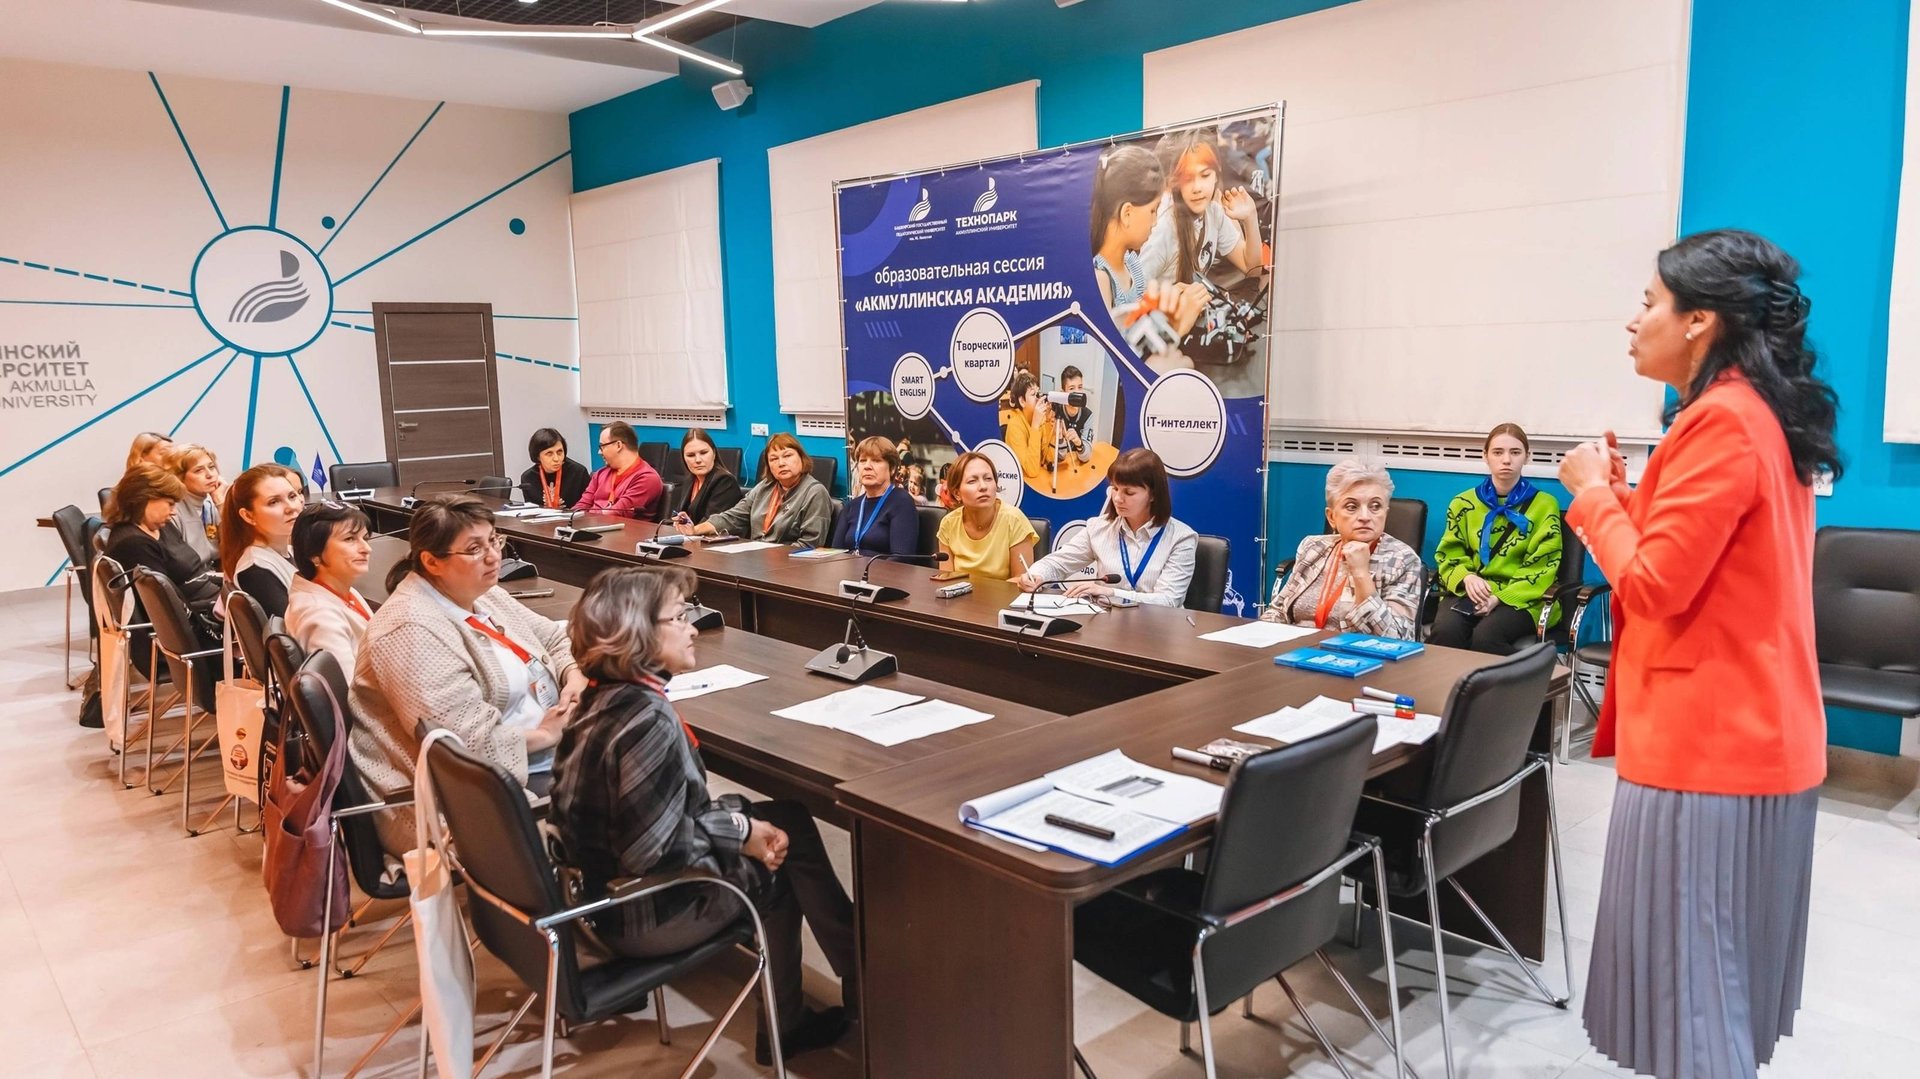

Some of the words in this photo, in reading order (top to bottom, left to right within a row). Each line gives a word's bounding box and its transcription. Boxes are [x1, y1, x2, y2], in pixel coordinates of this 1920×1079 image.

[955, 210, 1017, 228] ТЕХНОПАРК
[874, 260, 990, 286] образовательная
[993, 256, 1045, 273] сессия
[855, 288, 973, 312] «АКМУЛЛИНСКАЯ
[975, 281, 1073, 305] АКАДЕМИЯ»
[0, 341, 81, 359] НСКИЙ
[956, 339, 1009, 353] Творческий
[0, 362, 89, 378] РСИТЕТ
[964, 359, 1000, 370] квартал
[10, 379, 95, 393] AKMULLA
[901, 376, 924, 385] SMART
[899, 388, 927, 397] ENGLISH
[0, 394, 97, 409] NIVERSITY
[1146, 416, 1218, 430] IT-интеллект
[997, 470, 1018, 480] йские
